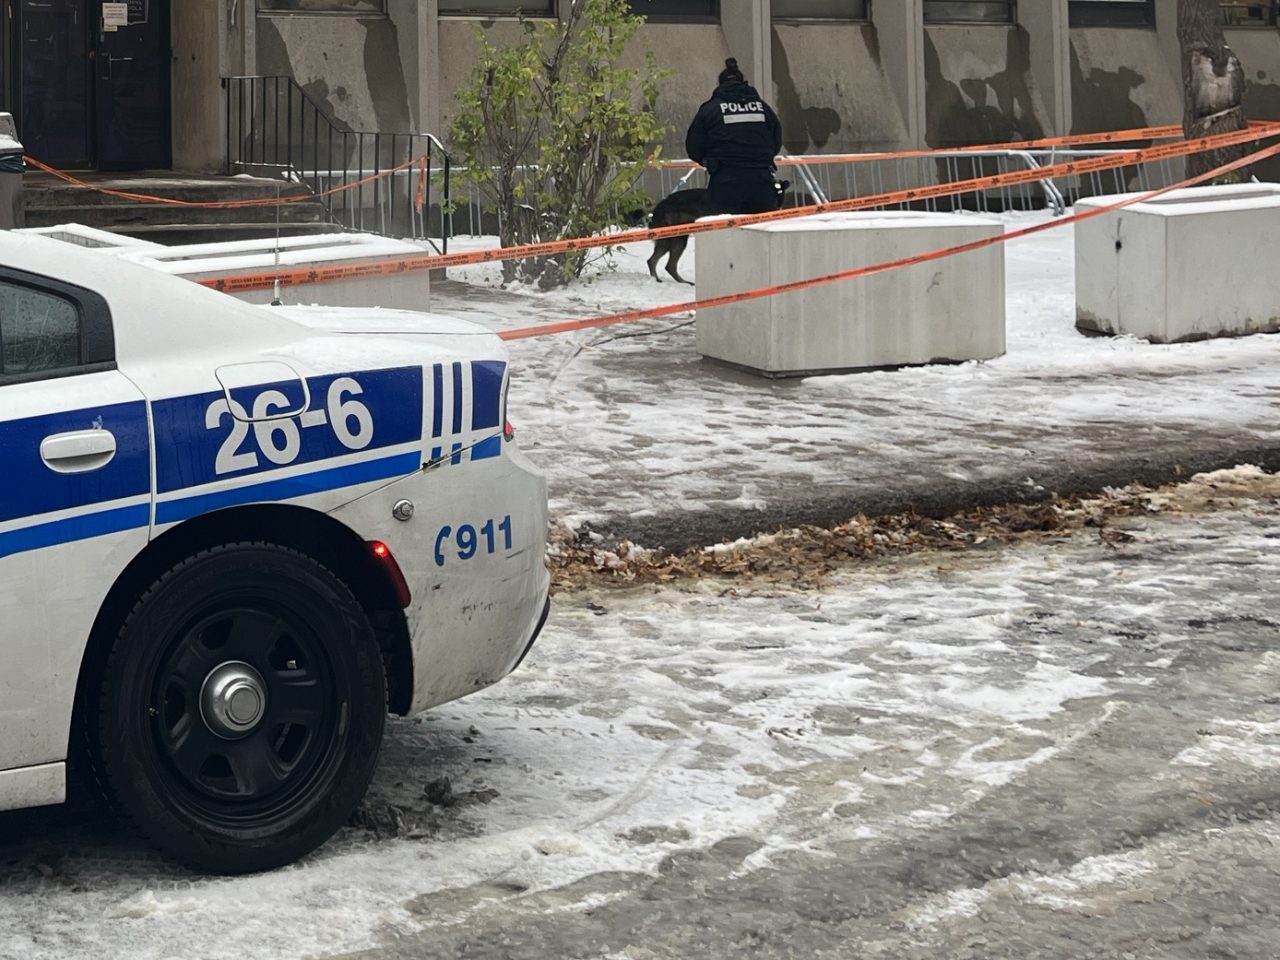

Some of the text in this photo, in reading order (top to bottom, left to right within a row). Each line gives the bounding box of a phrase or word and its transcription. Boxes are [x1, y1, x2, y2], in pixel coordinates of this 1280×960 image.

[719, 101, 764, 114] POLICE
[205, 377, 375, 475] 26-6
[455, 515, 513, 560] 911
